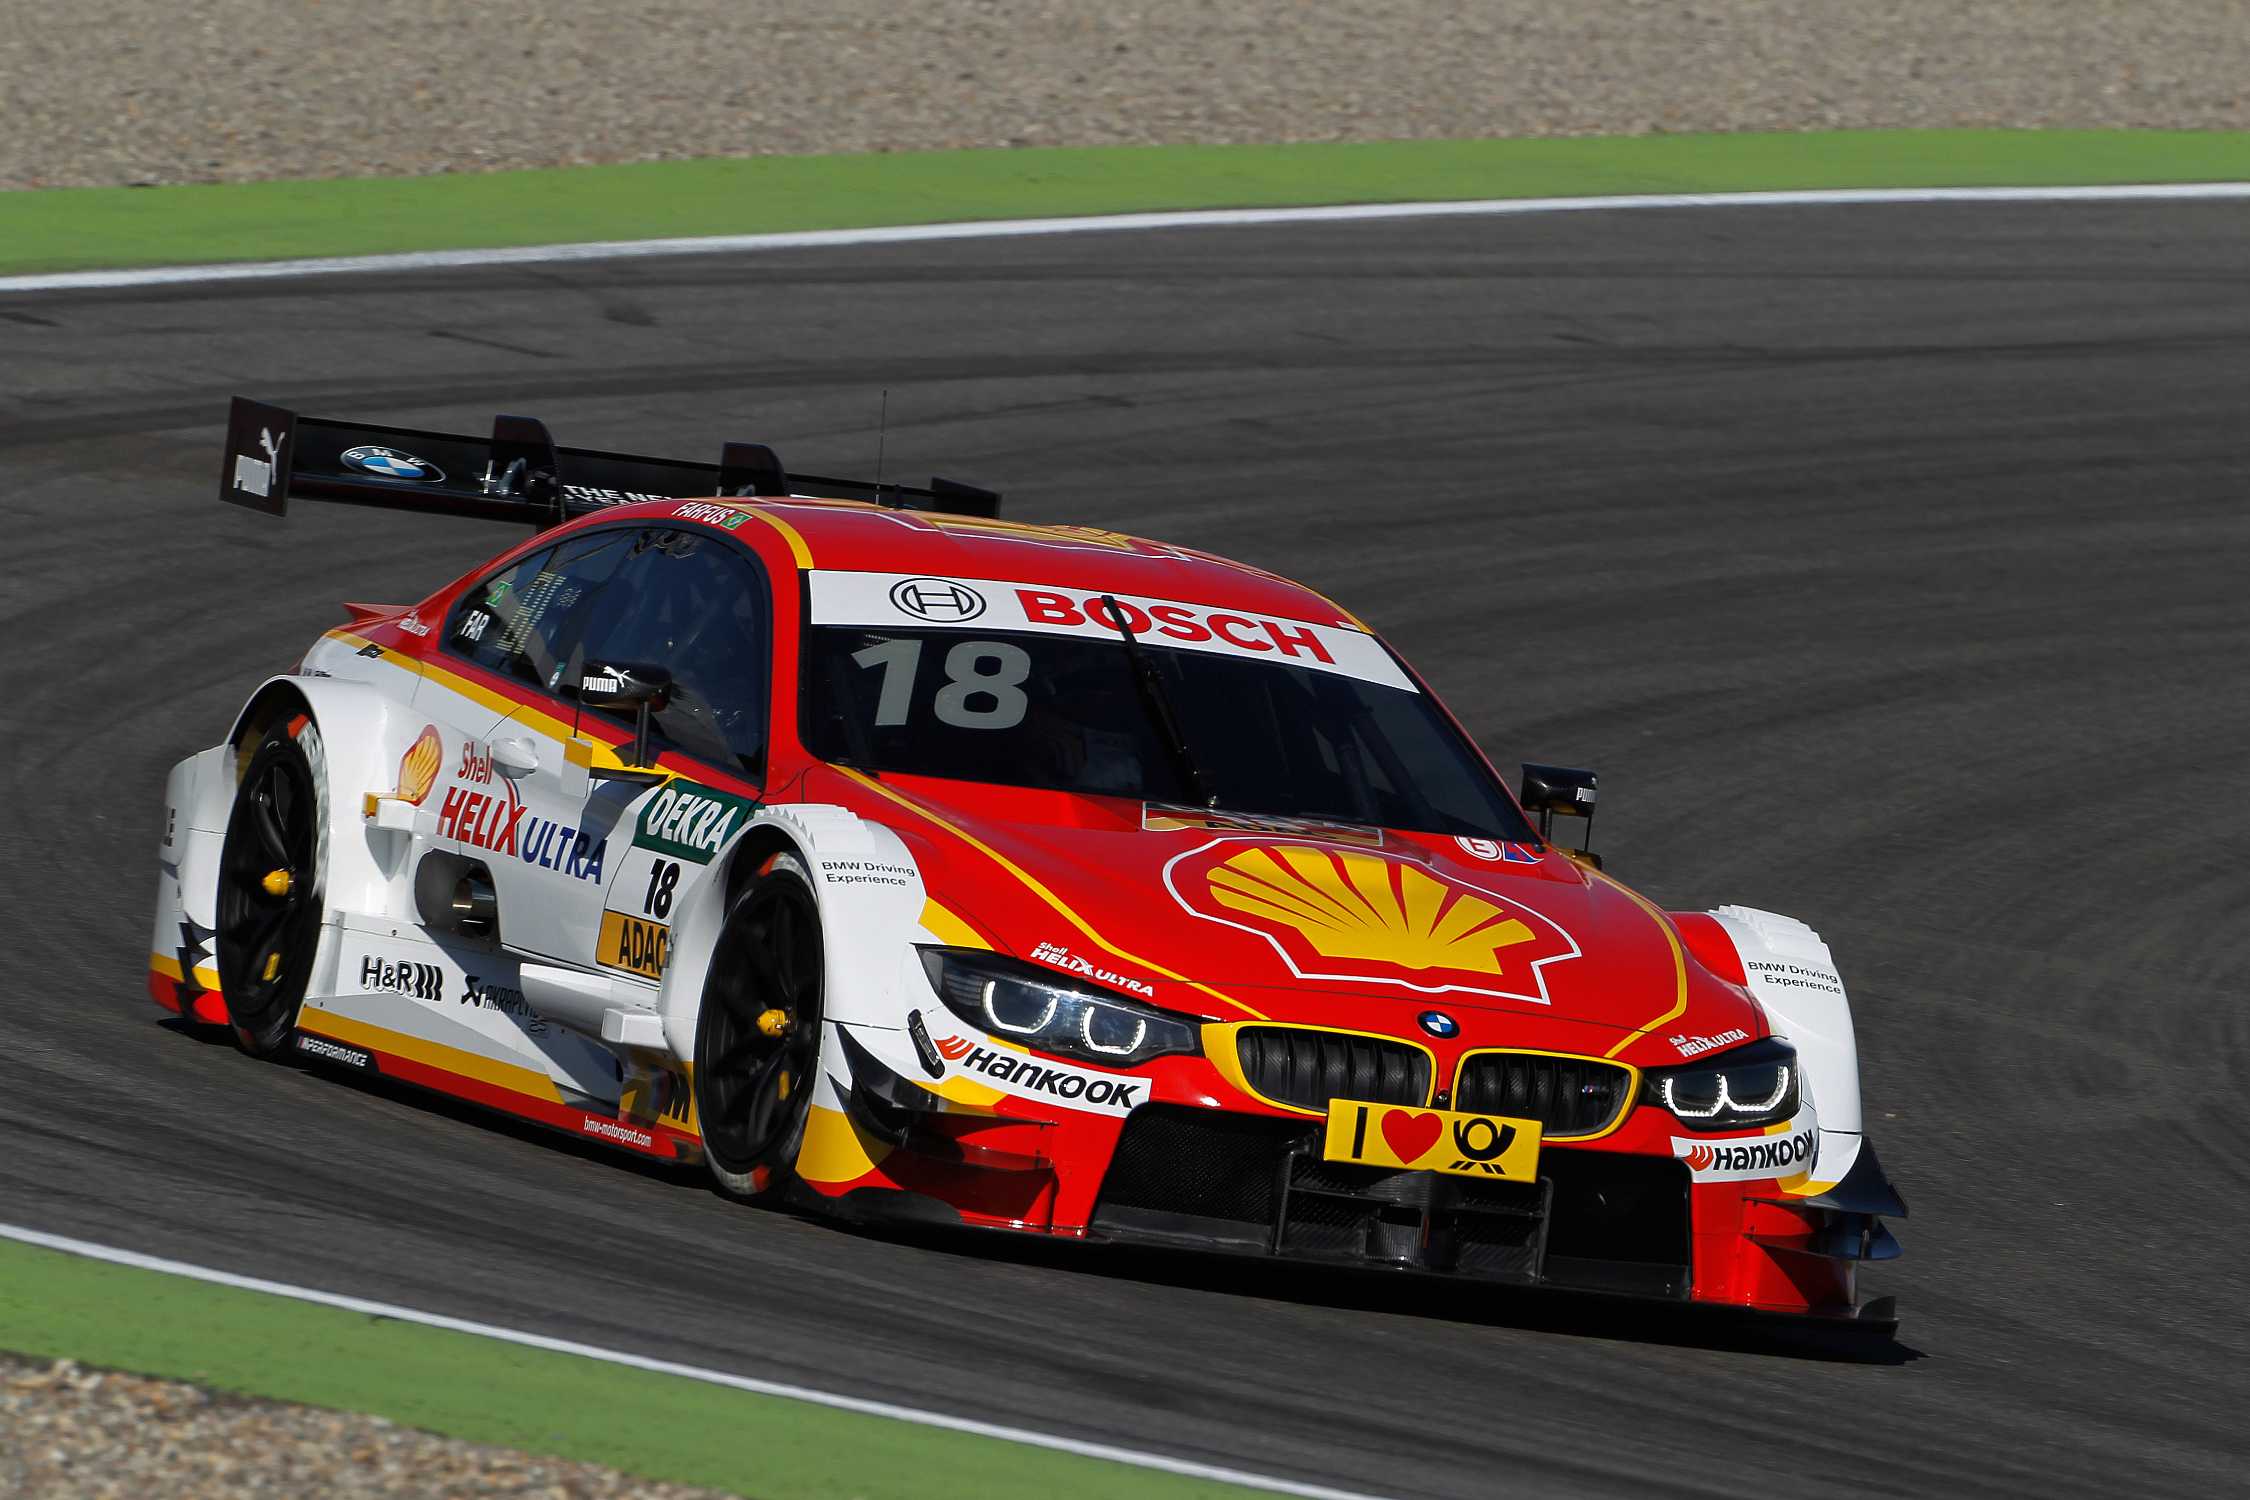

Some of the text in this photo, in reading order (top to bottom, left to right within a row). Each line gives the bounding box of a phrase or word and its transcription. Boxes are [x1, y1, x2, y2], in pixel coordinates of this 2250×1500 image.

[562, 485, 624, 500] THE
[671, 502, 736, 524] FARFUS
[460, 610, 490, 641] FAR
[1015, 589, 1337, 665] BOSCH
[582, 676, 618, 693] PUMA
[850, 639, 1031, 730] 18
[458, 741, 495, 785] Shell
[436, 786, 608, 885] HELIX ULTRA
[646, 788, 738, 853] DEKRA
[821, 861, 916, 878] BMW Driving
[826, 873, 907, 887] Experience
[644, 858, 681, 920] 18
[619, 919, 667, 975] ADAC
[362, 956, 413, 992] H&R
[1030, 948, 1154, 997] HELIX ULTRA
[1747, 961, 1839, 985] BMW Driving
[1763, 974, 1841, 994] Experience
[1711, 1028, 1749, 1047] ULTRA
[583, 1115, 652, 1147] bmw-motorsport.com
[1351, 1106, 1368, 1159] I
